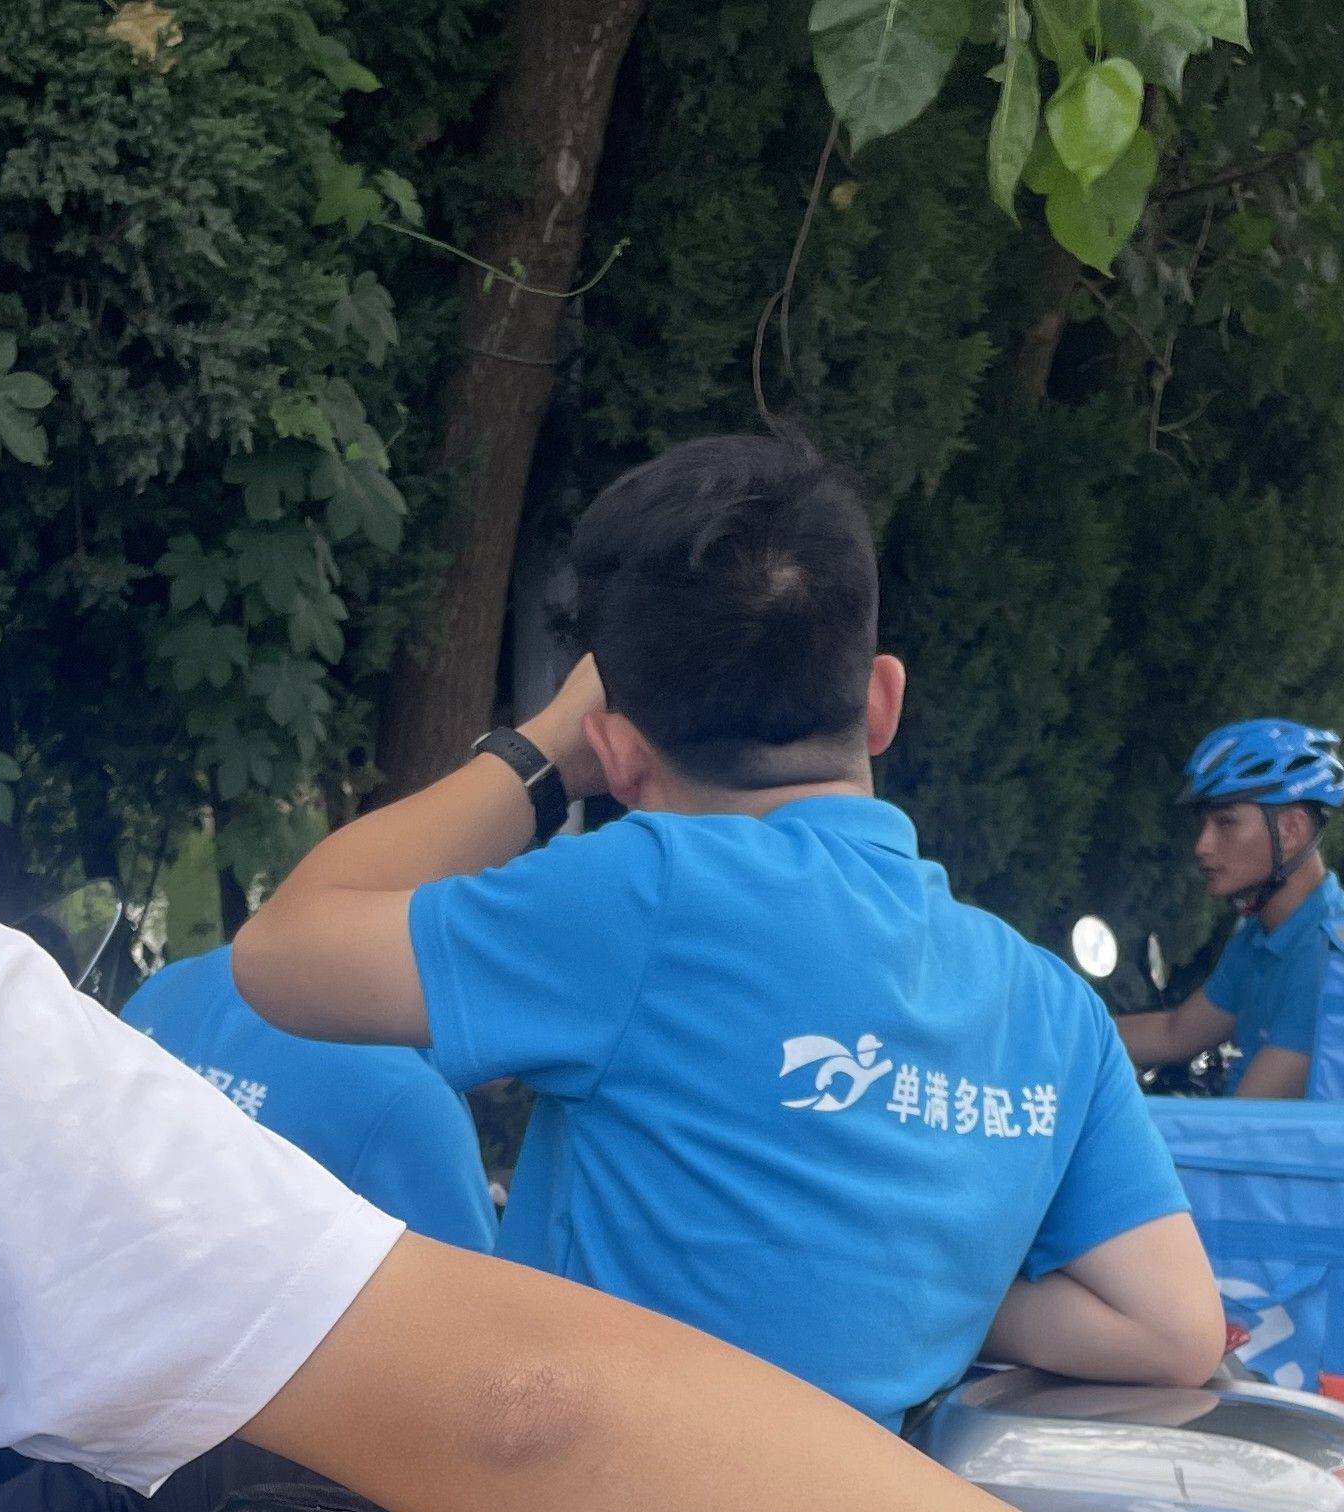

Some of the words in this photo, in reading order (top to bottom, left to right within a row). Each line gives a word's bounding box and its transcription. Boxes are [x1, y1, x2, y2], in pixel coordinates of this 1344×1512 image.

[886, 1063, 1058, 1138] 单满多配送
